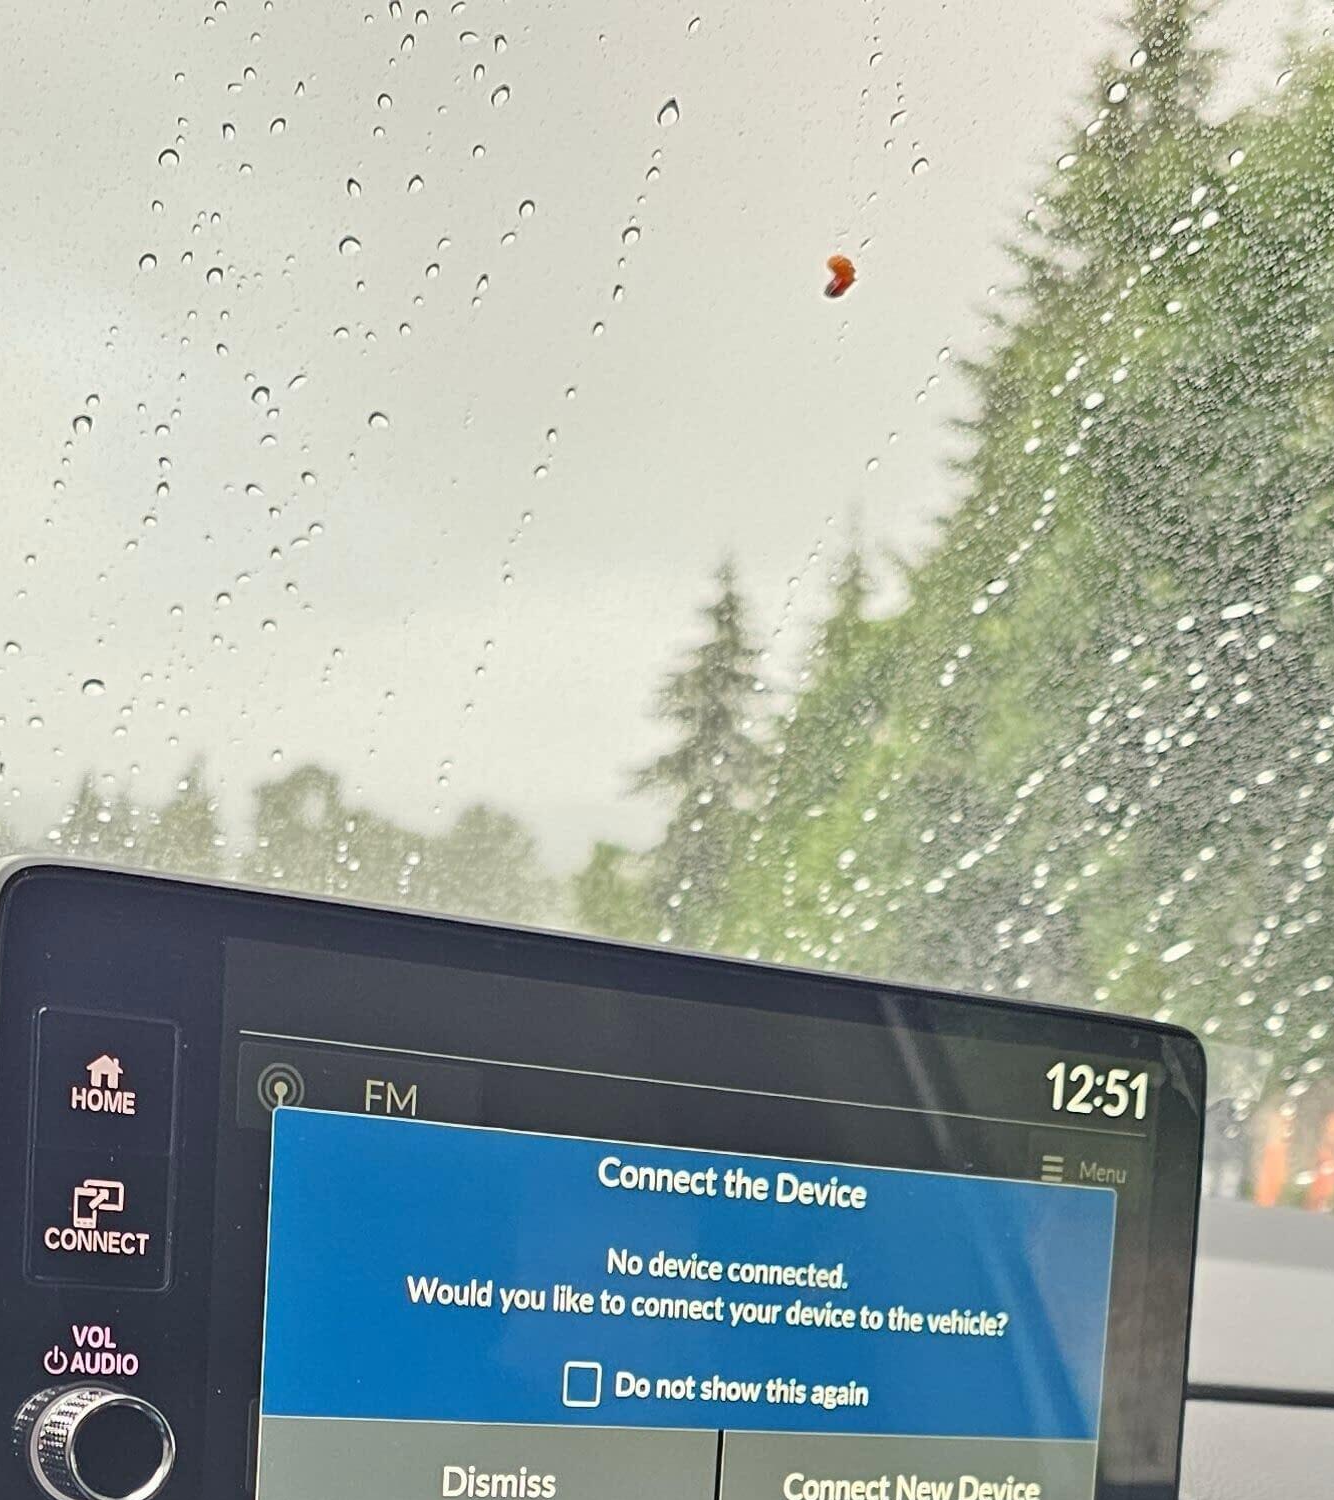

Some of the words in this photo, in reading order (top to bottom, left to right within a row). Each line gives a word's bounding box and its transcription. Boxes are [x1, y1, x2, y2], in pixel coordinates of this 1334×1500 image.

[71, 1086, 137, 1115] HOME
[365, 1079, 417, 1117] FM
[1046, 1061, 1149, 1120] 12:51
[598, 1156, 718, 1196] Connect
[723, 1168, 769, 1201] the
[775, 1173, 868, 1210] Device
[1079, 1160, 1126, 1184] Menu
[44, 1227, 150, 1255] CONNECT
[607, 1248, 643, 1276] No
[648, 1251, 723, 1282] device
[727, 1261, 849, 1290] connected.
[407, 1275, 493, 1308] Would
[499, 1286, 546, 1314] you
[553, 1285, 595, 1314] like
[600, 1289, 626, 1316] to
[631, 1296, 724, 1322] connect
[729, 1303, 782, 1328] your
[785, 1300, 855, 1330] device
[860, 1307, 884, 1331] to
[887, 1306, 923, 1334] the
[927, 1309, 1009, 1338] vehicle?
[72, 1325, 117, 1349] VOL
[70, 1351, 139, 1376] AUDIO
[615, 1371, 650, 1399] Do
[655, 1376, 695, 1400] not
[700, 1375, 762, 1402] show
[766, 1378, 807, 1404] this
[811, 1380, 870, 1410] again
[442, 1465, 557, 1500] Dismiss
